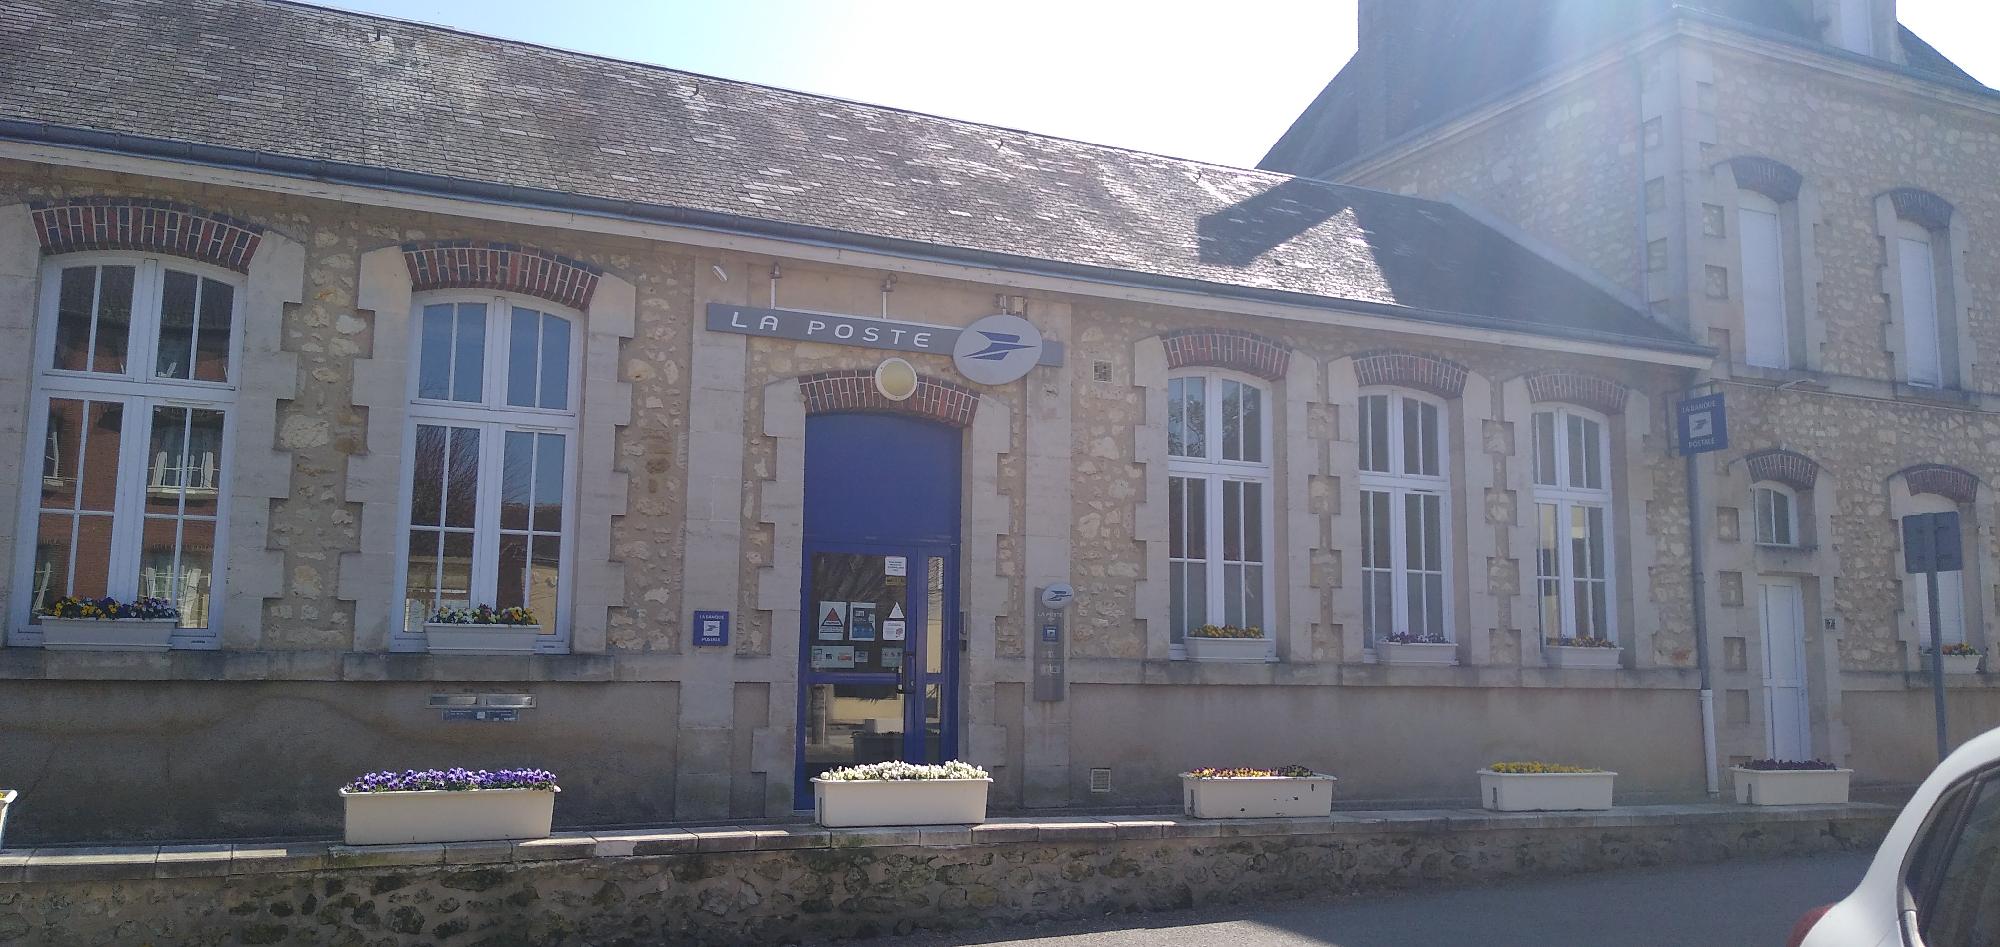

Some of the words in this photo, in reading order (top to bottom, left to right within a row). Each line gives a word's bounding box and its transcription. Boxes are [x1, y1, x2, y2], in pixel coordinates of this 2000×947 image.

[731, 311, 778, 331] LA
[807, 320, 932, 348] POSTE
[1690, 400, 1716, 412] BANQUE
[1688, 438, 1715, 448] POSTALE
